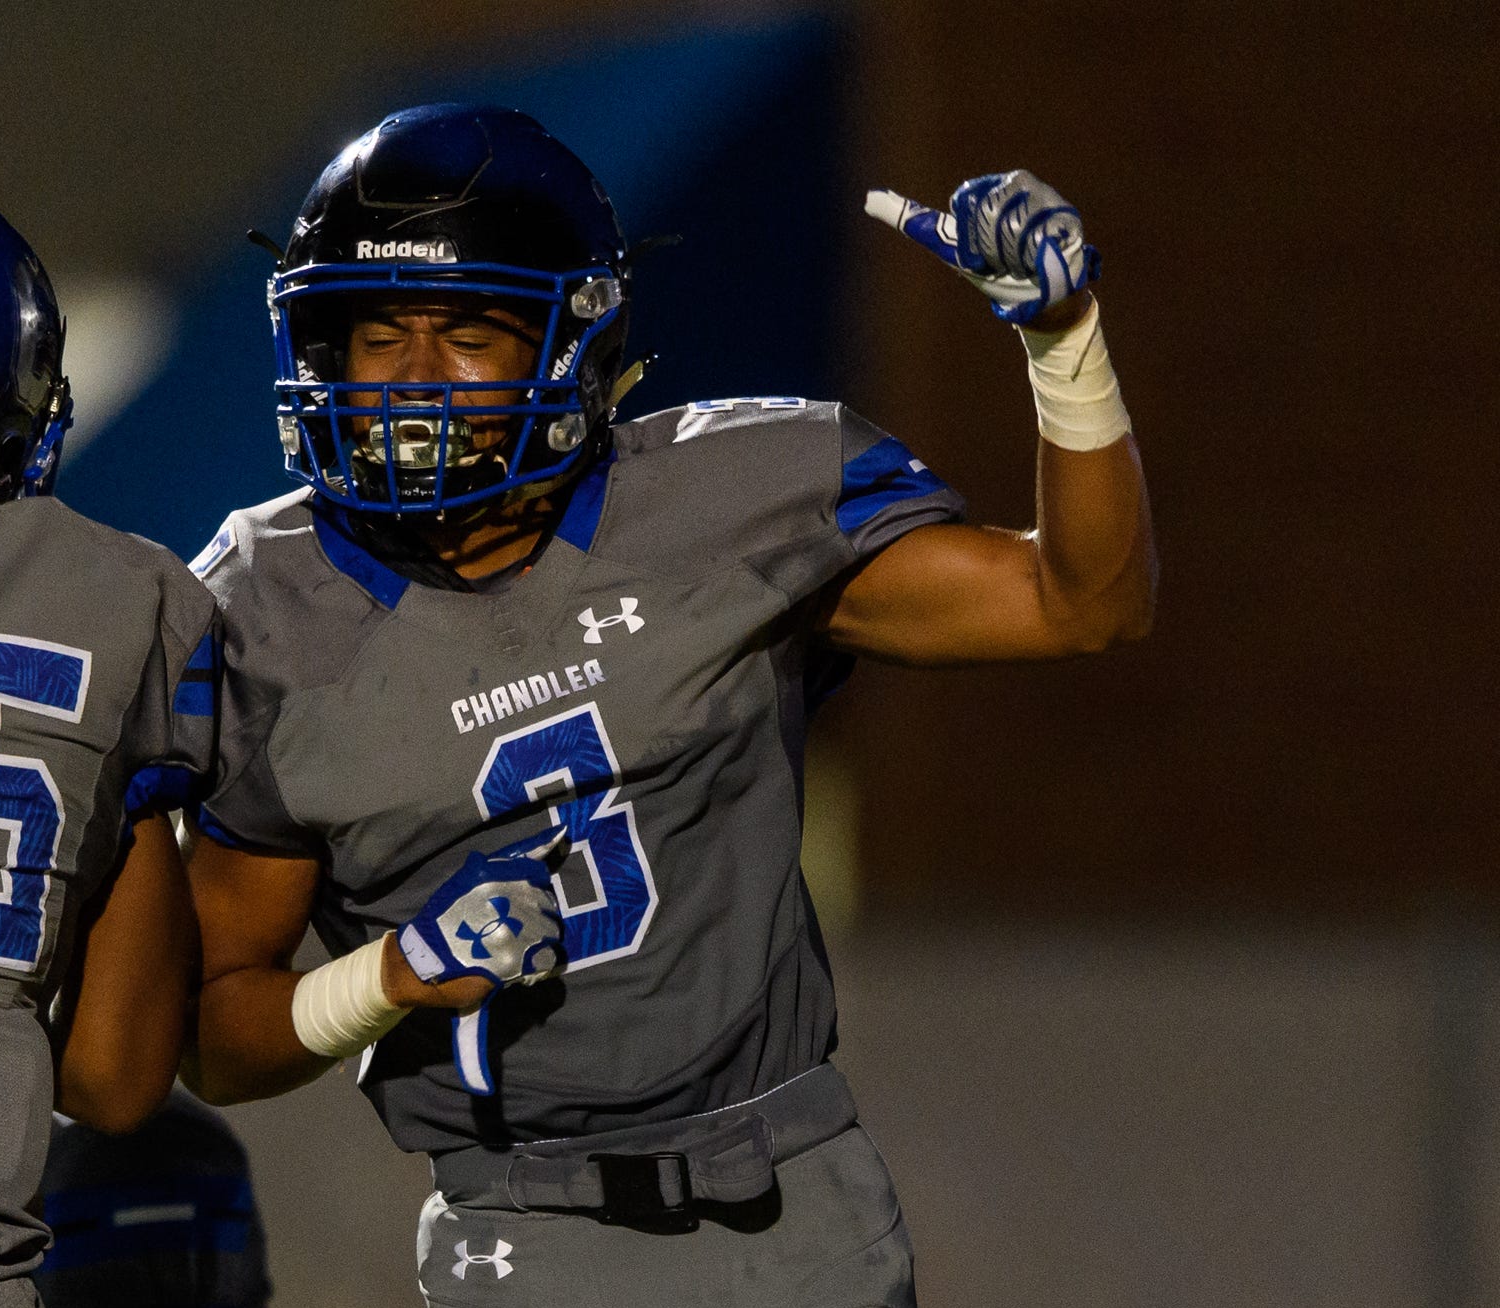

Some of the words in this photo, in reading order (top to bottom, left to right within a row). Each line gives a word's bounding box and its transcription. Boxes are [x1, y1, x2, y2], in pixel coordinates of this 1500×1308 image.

[357, 240, 445, 259] Riddell
[451, 658, 607, 735] CHANDLER
[472, 700, 660, 975] 3
